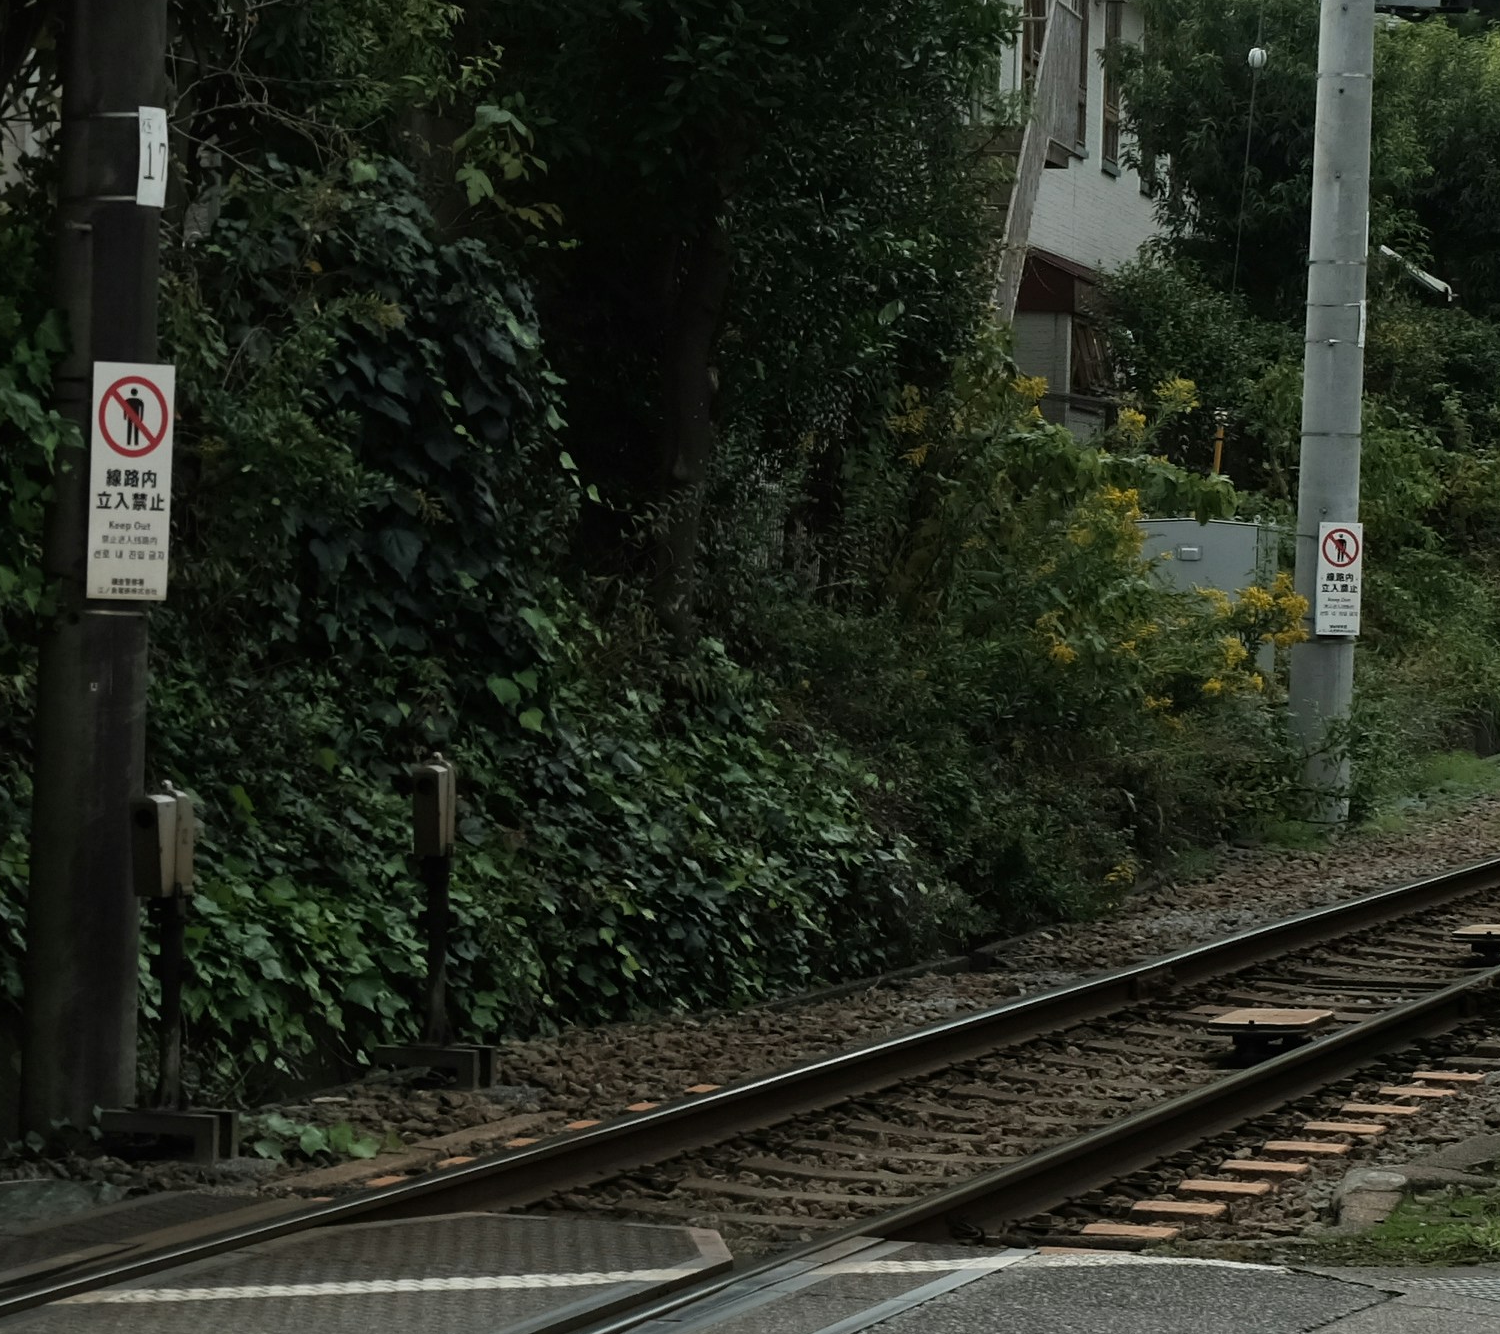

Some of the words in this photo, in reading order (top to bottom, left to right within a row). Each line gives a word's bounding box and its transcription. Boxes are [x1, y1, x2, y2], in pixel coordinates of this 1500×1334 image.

[106, 468, 157, 488] 線路内
[96, 492, 165, 512] 立入禁止
[109, 521, 131, 531] Keep
[134, 522, 150, 530] Out
